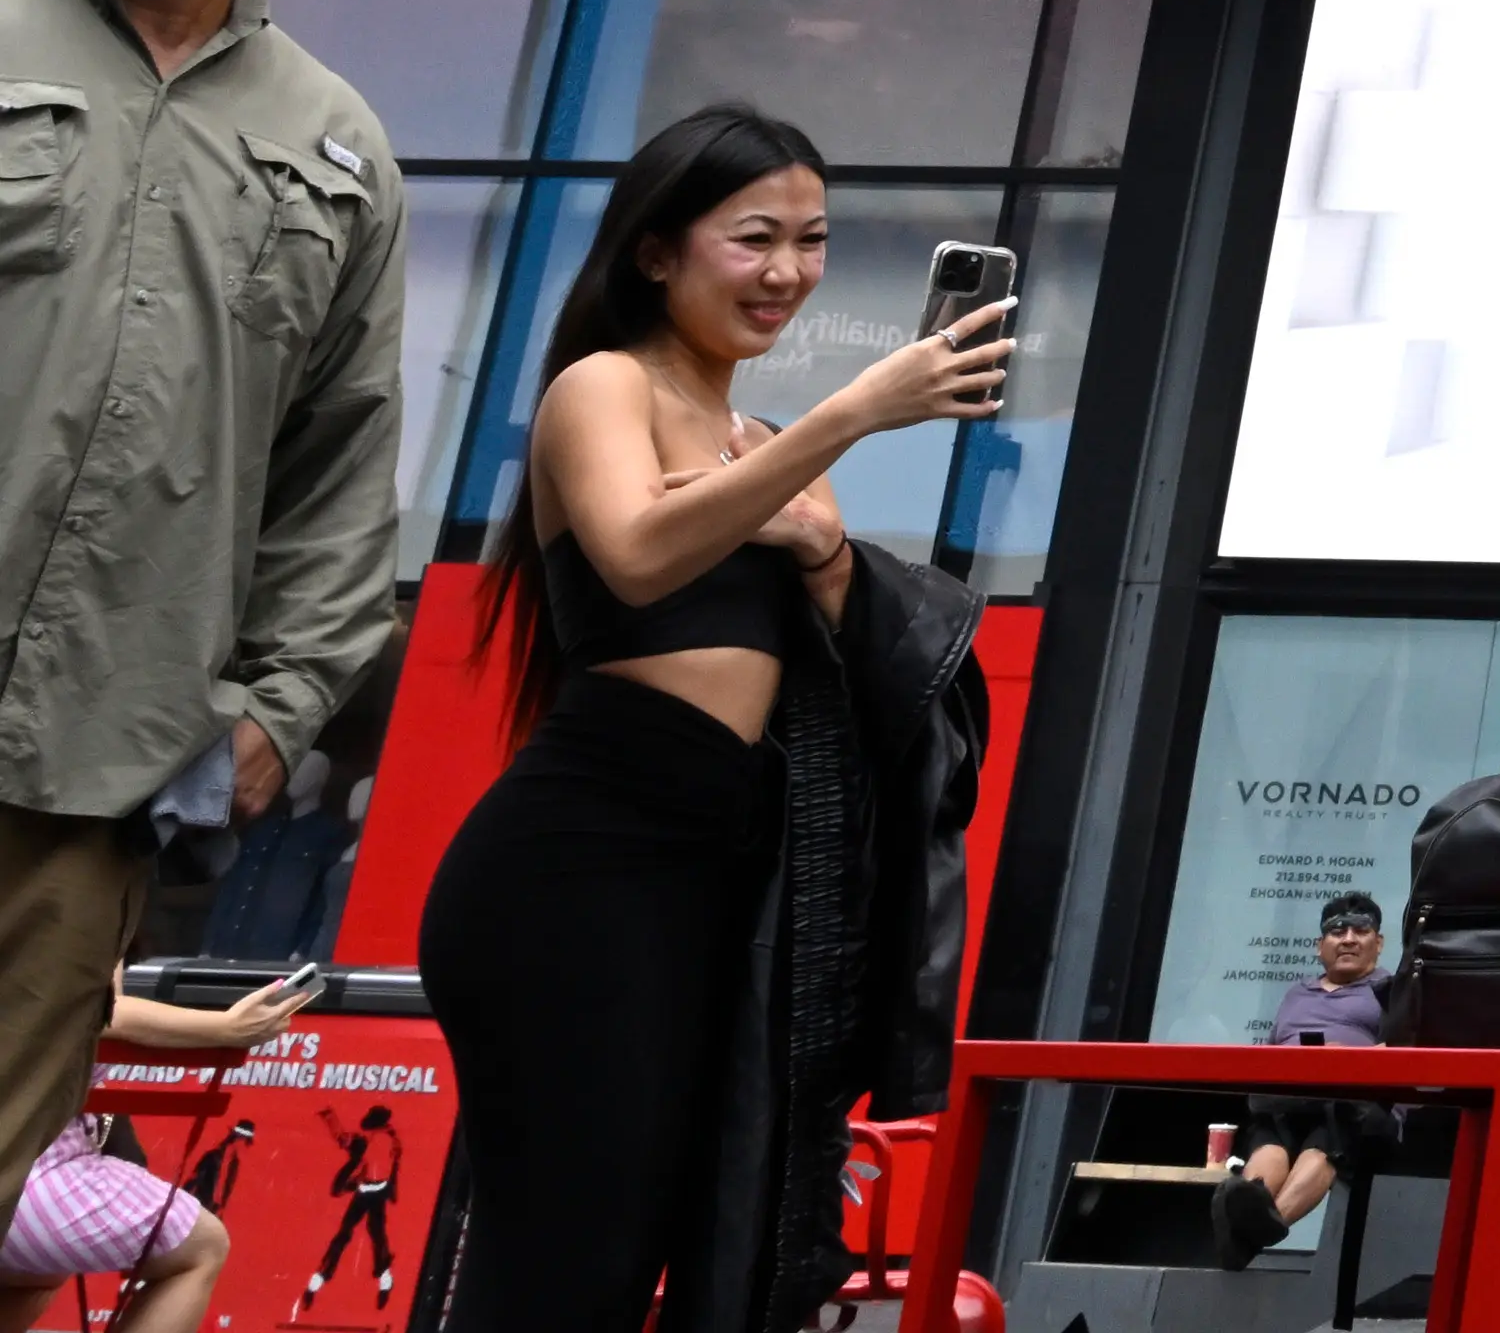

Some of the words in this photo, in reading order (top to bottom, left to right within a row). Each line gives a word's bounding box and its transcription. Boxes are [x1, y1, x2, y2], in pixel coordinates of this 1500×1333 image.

[1237, 780, 1421, 807] VORNADO
[1262, 809, 1326, 820] REALTY
[1334, 811, 1389, 821] TRUST
[1258, 854, 1313, 866] EDWARD
[1316, 855, 1326, 867] P.
[1329, 856, 1376, 868] HOGAN
[1247, 936, 1289, 948] JASON
[319, 1062, 440, 1093] MUSICAL
